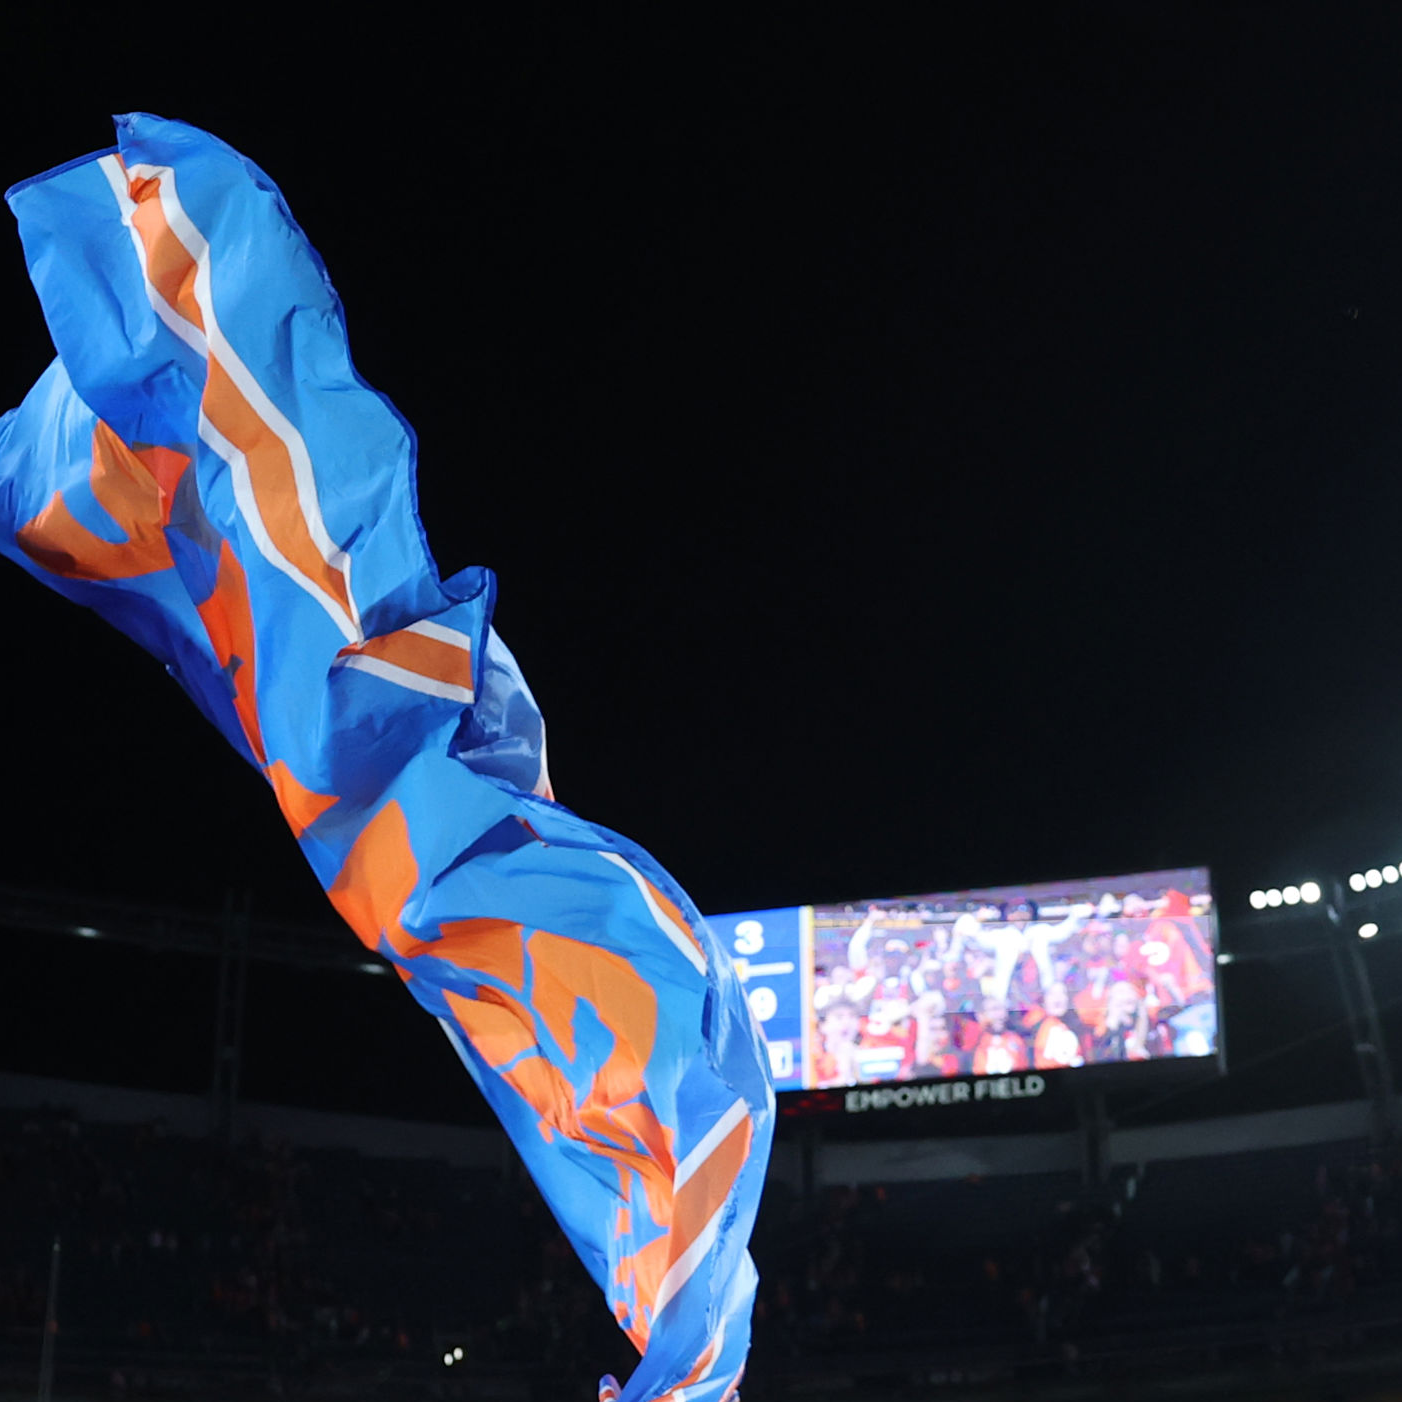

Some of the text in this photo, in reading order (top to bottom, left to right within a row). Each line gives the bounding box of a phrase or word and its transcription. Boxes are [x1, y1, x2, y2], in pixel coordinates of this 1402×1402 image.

[734, 920, 765, 955] 3
[845, 1074, 1046, 1113] EMPOWER FIELD
